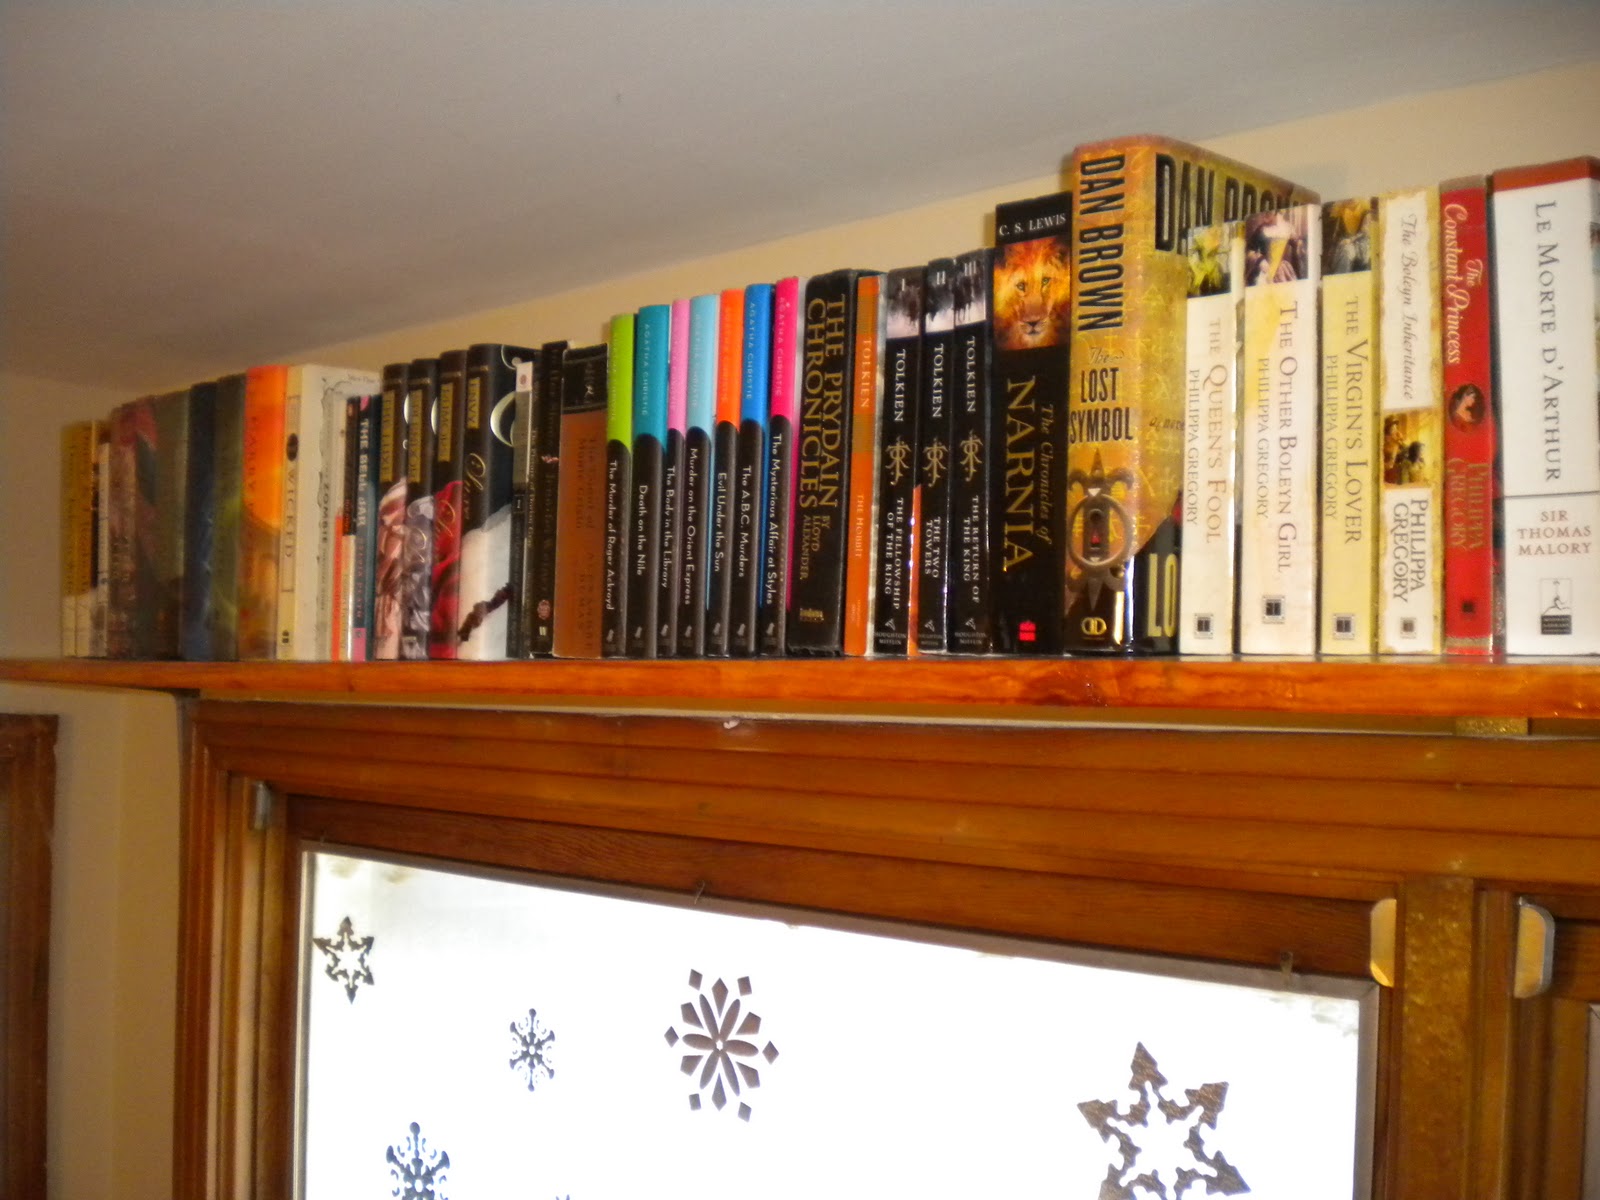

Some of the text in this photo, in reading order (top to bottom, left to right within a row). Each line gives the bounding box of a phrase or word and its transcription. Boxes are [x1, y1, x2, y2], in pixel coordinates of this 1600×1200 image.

[998, 213, 1067, 236] C. S. LEWIS
[1078, 154, 1126, 331] DAN BROWN
[1155, 152, 1215, 255] DAN
[1535, 201, 1557, 234] LE
[1398, 213, 1419, 400] The Boleyn Inheritance
[1444, 203, 1471, 365] Constant Princess
[1465, 258, 1484, 288] The
[1538, 242, 1560, 334] MORTE
[641, 323, 651, 417] AGATHA CHRISTIE
[745, 302, 757, 400] AGATHA CHRISTIE
[775, 297, 786, 397] AGATHA CHRISTIE
[860, 337, 872, 409] TOLKIEN
[894, 348, 907, 422] TOLKIEN
[932, 343, 944, 419] TOLKIEN
[966, 336, 977, 413] TOLKIEN
[1080, 367, 1119, 404] LOST
[359, 418, 370, 450] THE
[800, 298, 826, 508] CHRONICLES
[818, 293, 846, 508] THE PRYDAIN
[1069, 406, 1134, 444] SYMBOL
[1202, 317, 1229, 544] THE QUEEN'S FOOL
[1256, 357, 1270, 519] PHILIPPA GREGORY
[1277, 300, 1299, 574] THE OTHER BOLEYN GIRL
[1324, 354, 1338, 521] PHILIPPA GREGORY
[1345, 296, 1369, 545] THE VIRGIN'S LOVER
[742, 465, 752, 487] The
[1003, 375, 1037, 573] NARNIA
[1036, 403, 1055, 546] The Chronicles of
[1185, 369, 1200, 526] PHILIPPA GREGORY
[285, 468, 298, 559] WICKED
[605, 459, 618, 611] The Murder of Roger Ackroyd
[636, 484, 648, 577] Death on the Nile
[661, 466, 676, 589] The Body in the Library
[684, 447, 699, 606] Murder on the Orient Express
[714, 472, 727, 572] Evil Under the Sun
[738, 532, 749, 578] Murders
[766, 433, 782, 606] The Mysterious Affair at Styles
[811, 514, 822, 553] LLOYD
[884, 511, 895, 595] OF THE RING
[892, 497, 904, 610] THE FELLOWSHIP
[924, 519, 933, 575] TOWERS
[931, 516, 941, 579] THE TWO
[963, 516, 971, 582] THE KING
[971, 526, 979, 581] RETURN
[1390, 502, 1409, 603] GREGORY
[1411, 498, 1429, 592] PHILIPPA
[1516, 525, 1592, 540] THOMAS
[1517, 542, 1593, 557] MALORY
[1540, 509, 1569, 523] SIR
[971, 585, 980, 604] OF
